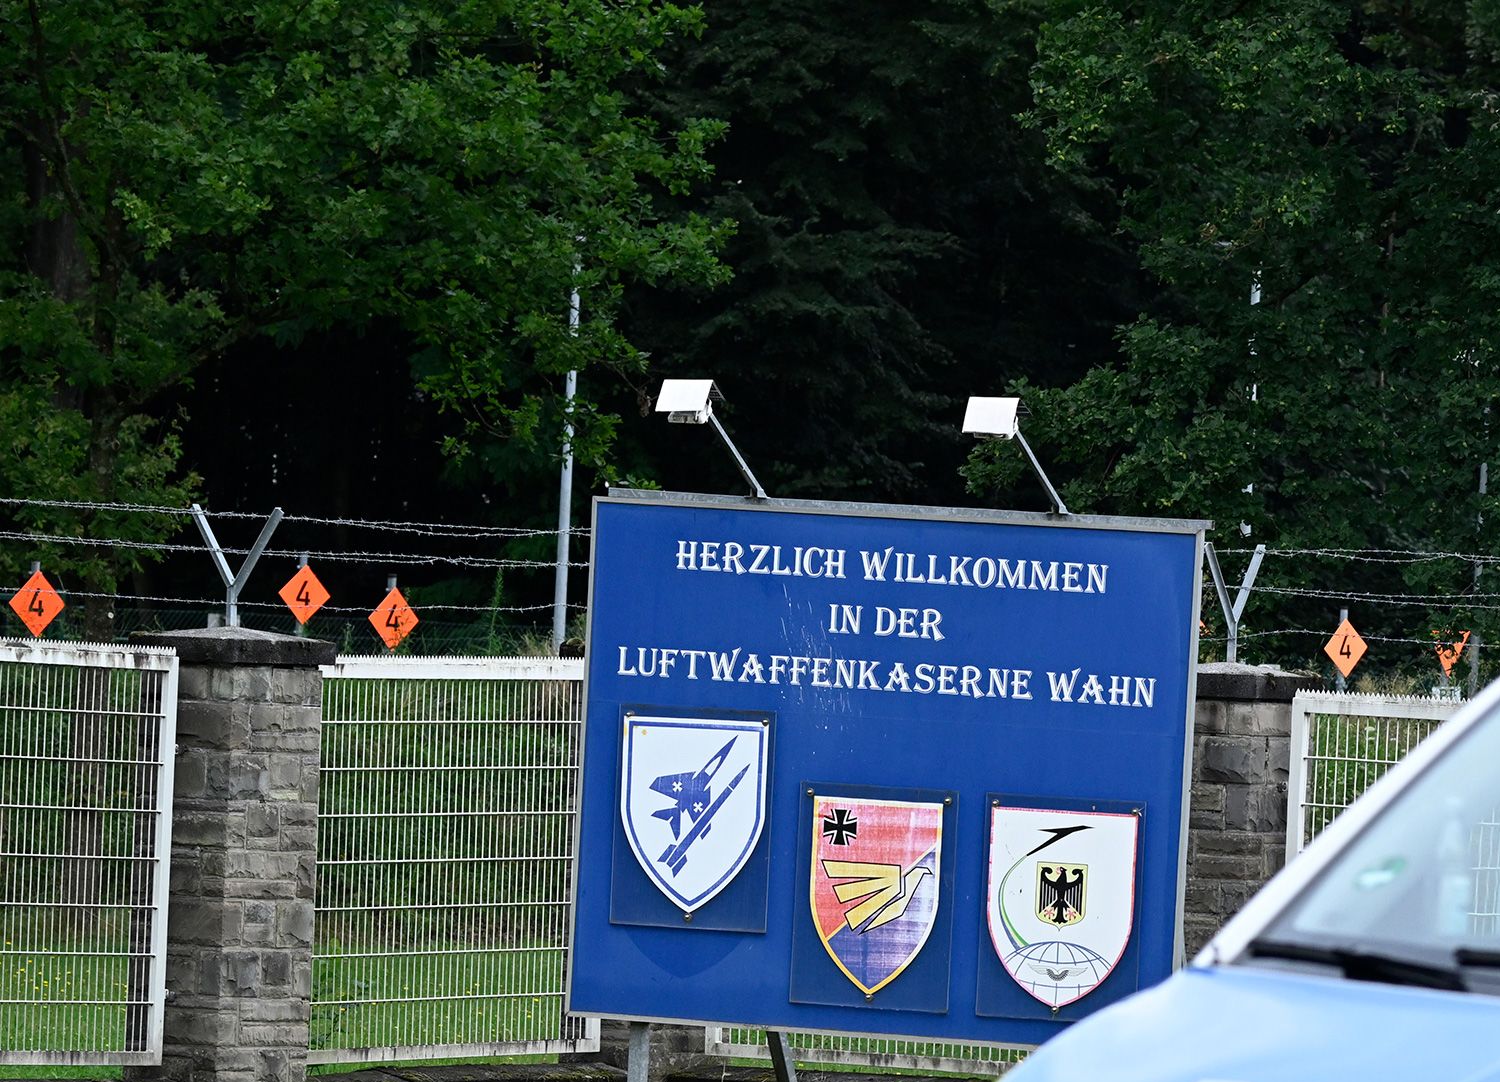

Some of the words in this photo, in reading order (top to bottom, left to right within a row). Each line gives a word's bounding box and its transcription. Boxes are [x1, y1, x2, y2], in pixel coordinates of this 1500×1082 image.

[676, 541, 847, 580] HERZLICH
[861, 546, 1109, 594] WILLKOMMEN
[28, 588, 44, 617] 4
[296, 580, 310, 606] 4
[385, 604, 401, 632] 4
[829, 604, 863, 636] IN
[874, 607, 946, 641] DER
[1339, 636, 1352, 659] 4
[617, 646, 1034, 701] LUFTWAFFENKASERNE
[1047, 667, 1157, 708] WAHN
